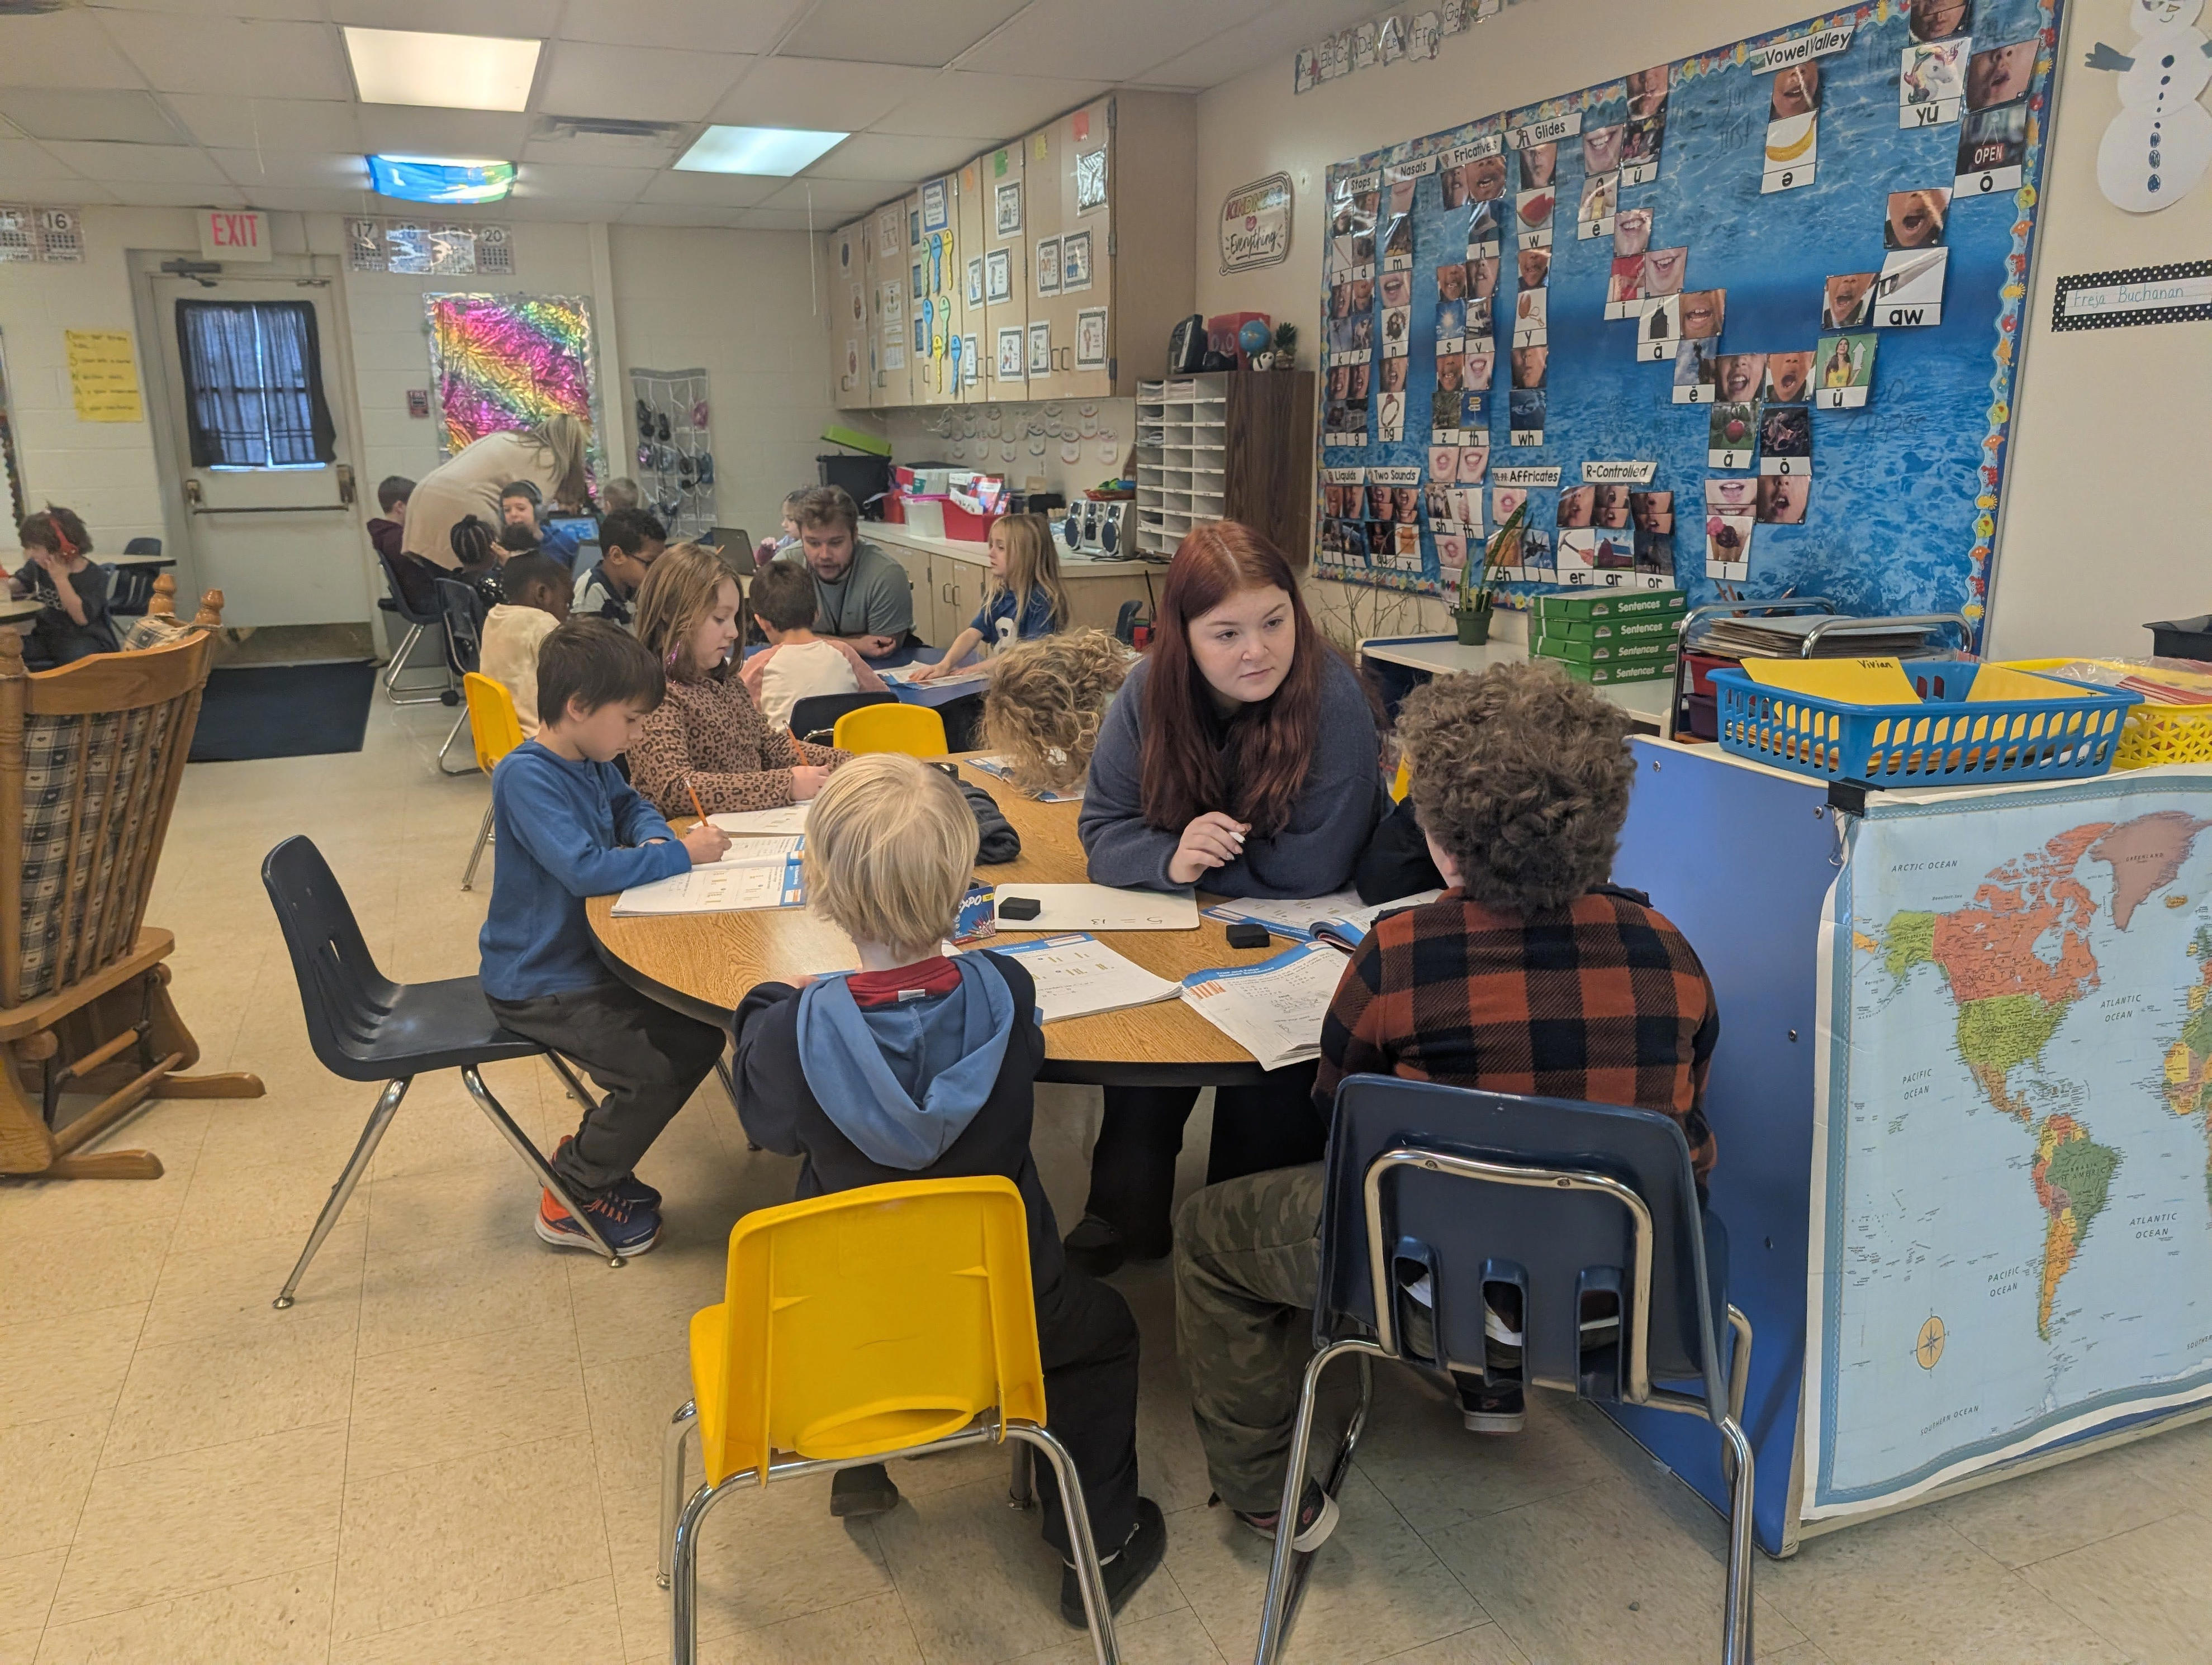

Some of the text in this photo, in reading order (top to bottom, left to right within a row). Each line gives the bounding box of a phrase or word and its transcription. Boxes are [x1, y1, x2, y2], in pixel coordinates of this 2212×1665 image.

[1358, 37, 1372, 54] Dd
[1445, 3, 1460, 27] Gg
[1765, 30, 1851, 66] Vowel Valley
[1916, 101, 1939, 127] yū
[1535, 121, 1565, 141] Glides
[1454, 141, 1497, 162] Fricatives
[1974, 145, 2003, 165] OPEN
[1400, 160, 1427, 177] Nasals
[1351, 177, 1371, 191] Stops
[1980, 170, 1993, 192] ō
[47, 212, 67, 230] 16
[1592, 221, 1601, 236] ē
[211, 213, 259, 247] EXIT
[357, 223, 374, 238] 17
[485, 229, 503, 242] 20
[1230, 226, 1277, 259] Everything
[1529, 235, 1540, 247] w
[1479, 243, 1486, 259] h
[1393, 258, 1403, 269] m
[1361, 267, 1366, 278] d
[2118, 283, 2183, 303] Buchanan
[1888, 307, 1923, 326] aw
[1525, 331, 1532, 346] y
[1391, 345, 1397, 356] n
[1446, 342, 1482, 353] s v
[1654, 343, 1662, 359] ā
[1354, 432, 1360, 446] g
[1384, 427, 1395, 441] ng
[1441, 431, 1479, 446] z th
[1517, 430, 1534, 446] wh
[1335, 470, 1356, 483] Liquids
[1374, 469, 1416, 481] Two Sounds
[1509, 470, 1558, 483] Affricates
[1586, 464, 1648, 479] R-Controlled
[1436, 518, 1446, 533] sh
[1463, 524, 1474, 538] th
[1406, 560, 1412, 571] x
[1497, 566, 1511, 581] ch
[1569, 572, 1586, 584] er
[1605, 573, 1622, 586] ar
[1648, 577, 1663, 589] or
[1617, 600, 1661, 613] Sentences
[1620, 622, 1663, 635] Sentences
[1618, 644, 1659, 657] Sentences
[1616, 665, 1655, 678] Sentences
[1857, 660, 1893, 669] Vivian
[2125, 852, 2164, 862] GREENLAND
[1891, 860, 1958, 873] ARCTIC OCEAN
[1147, 916, 1163, 925] 5
[1968, 958, 2081, 981] NORTH AMERICA
[2100, 994, 2142, 1009] ATLANTIC
[2105, 1010, 2134, 1022] OCEAN
[1902, 1068, 1932, 1084] PACIFIC
[1904, 1085, 1930, 1100] OCEAN
[2072, 1165, 2113, 1181] AMERICA
[2129, 1212, 2177, 1226] ATLANTIC
[2135, 1228, 2169, 1239] OCEAN
[1987, 1266, 2020, 1283] PACIFIC
[1990, 1282, 2018, 1297] OCEAN
[1920, 1405, 1979, 1436] SOUTHERN OCEAN
